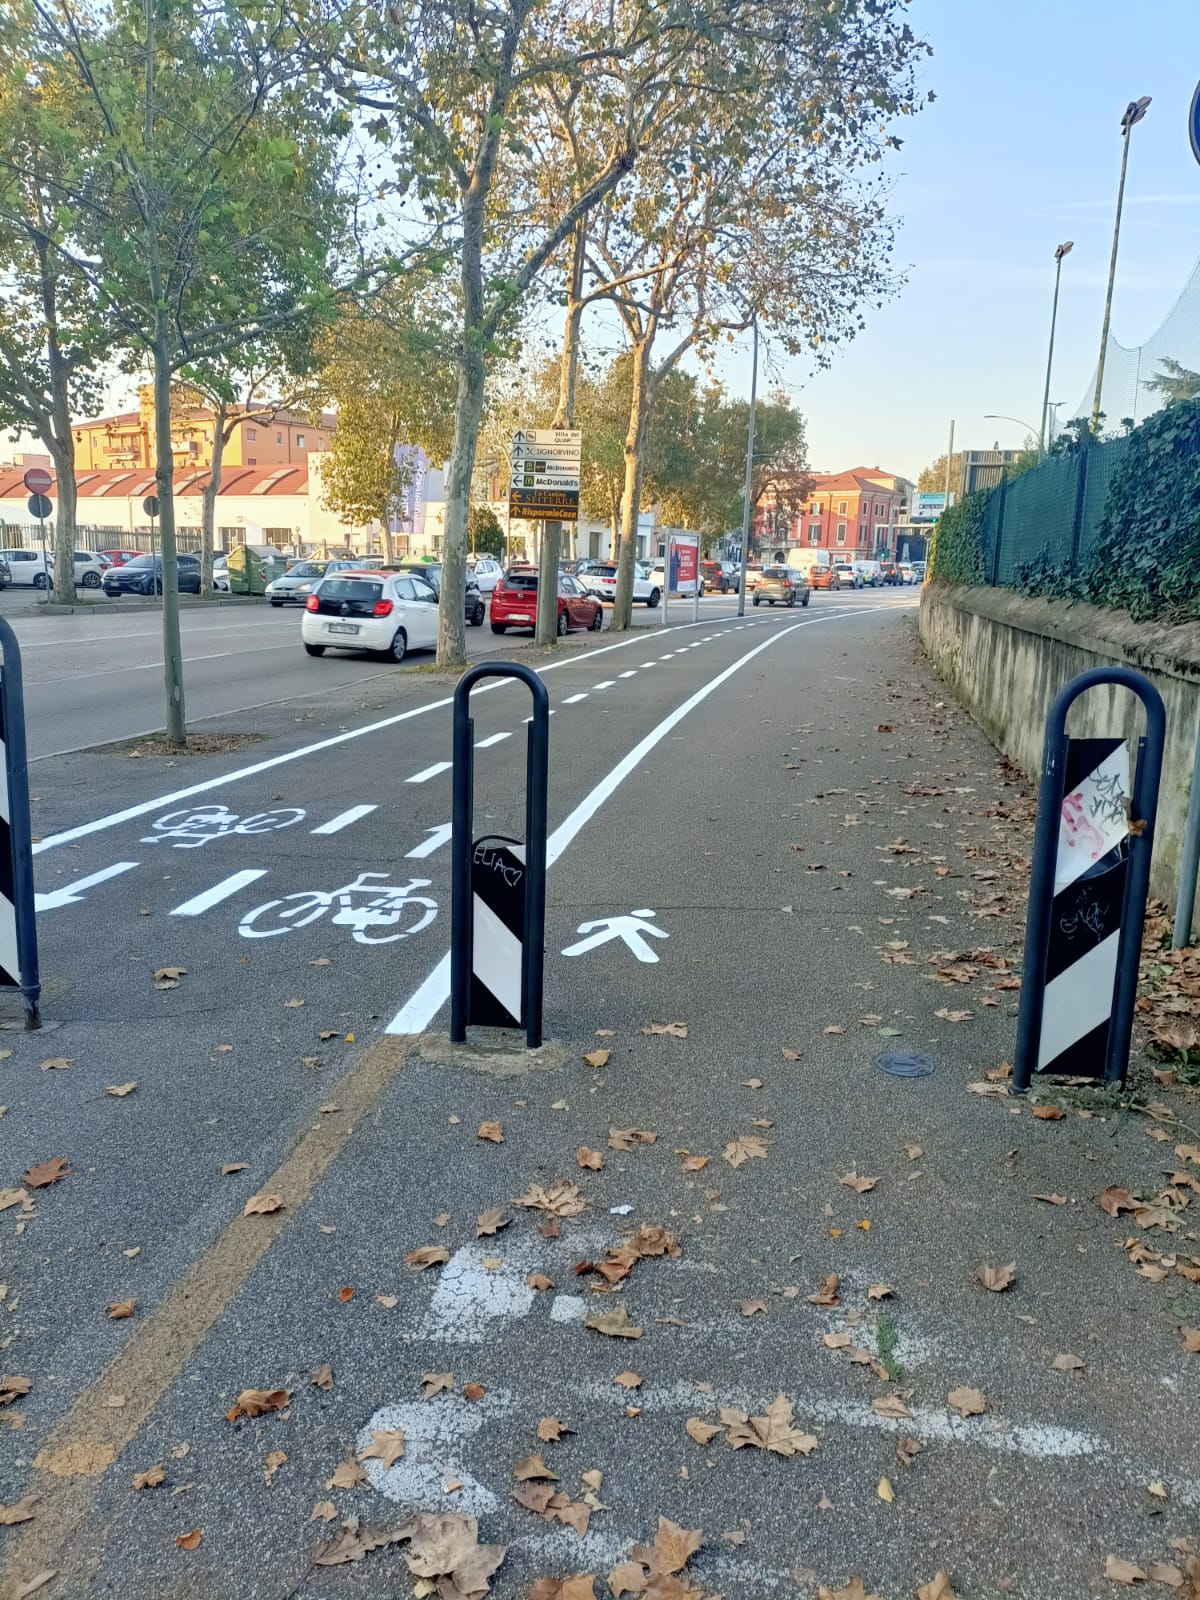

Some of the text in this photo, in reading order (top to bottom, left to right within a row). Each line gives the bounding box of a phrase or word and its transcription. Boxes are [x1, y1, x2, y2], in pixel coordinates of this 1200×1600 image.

[536, 448, 580, 456] SIGNORVINO
[536, 478, 578, 487] McDonald's
[522, 506, 577, 518] RisparmioCasa
